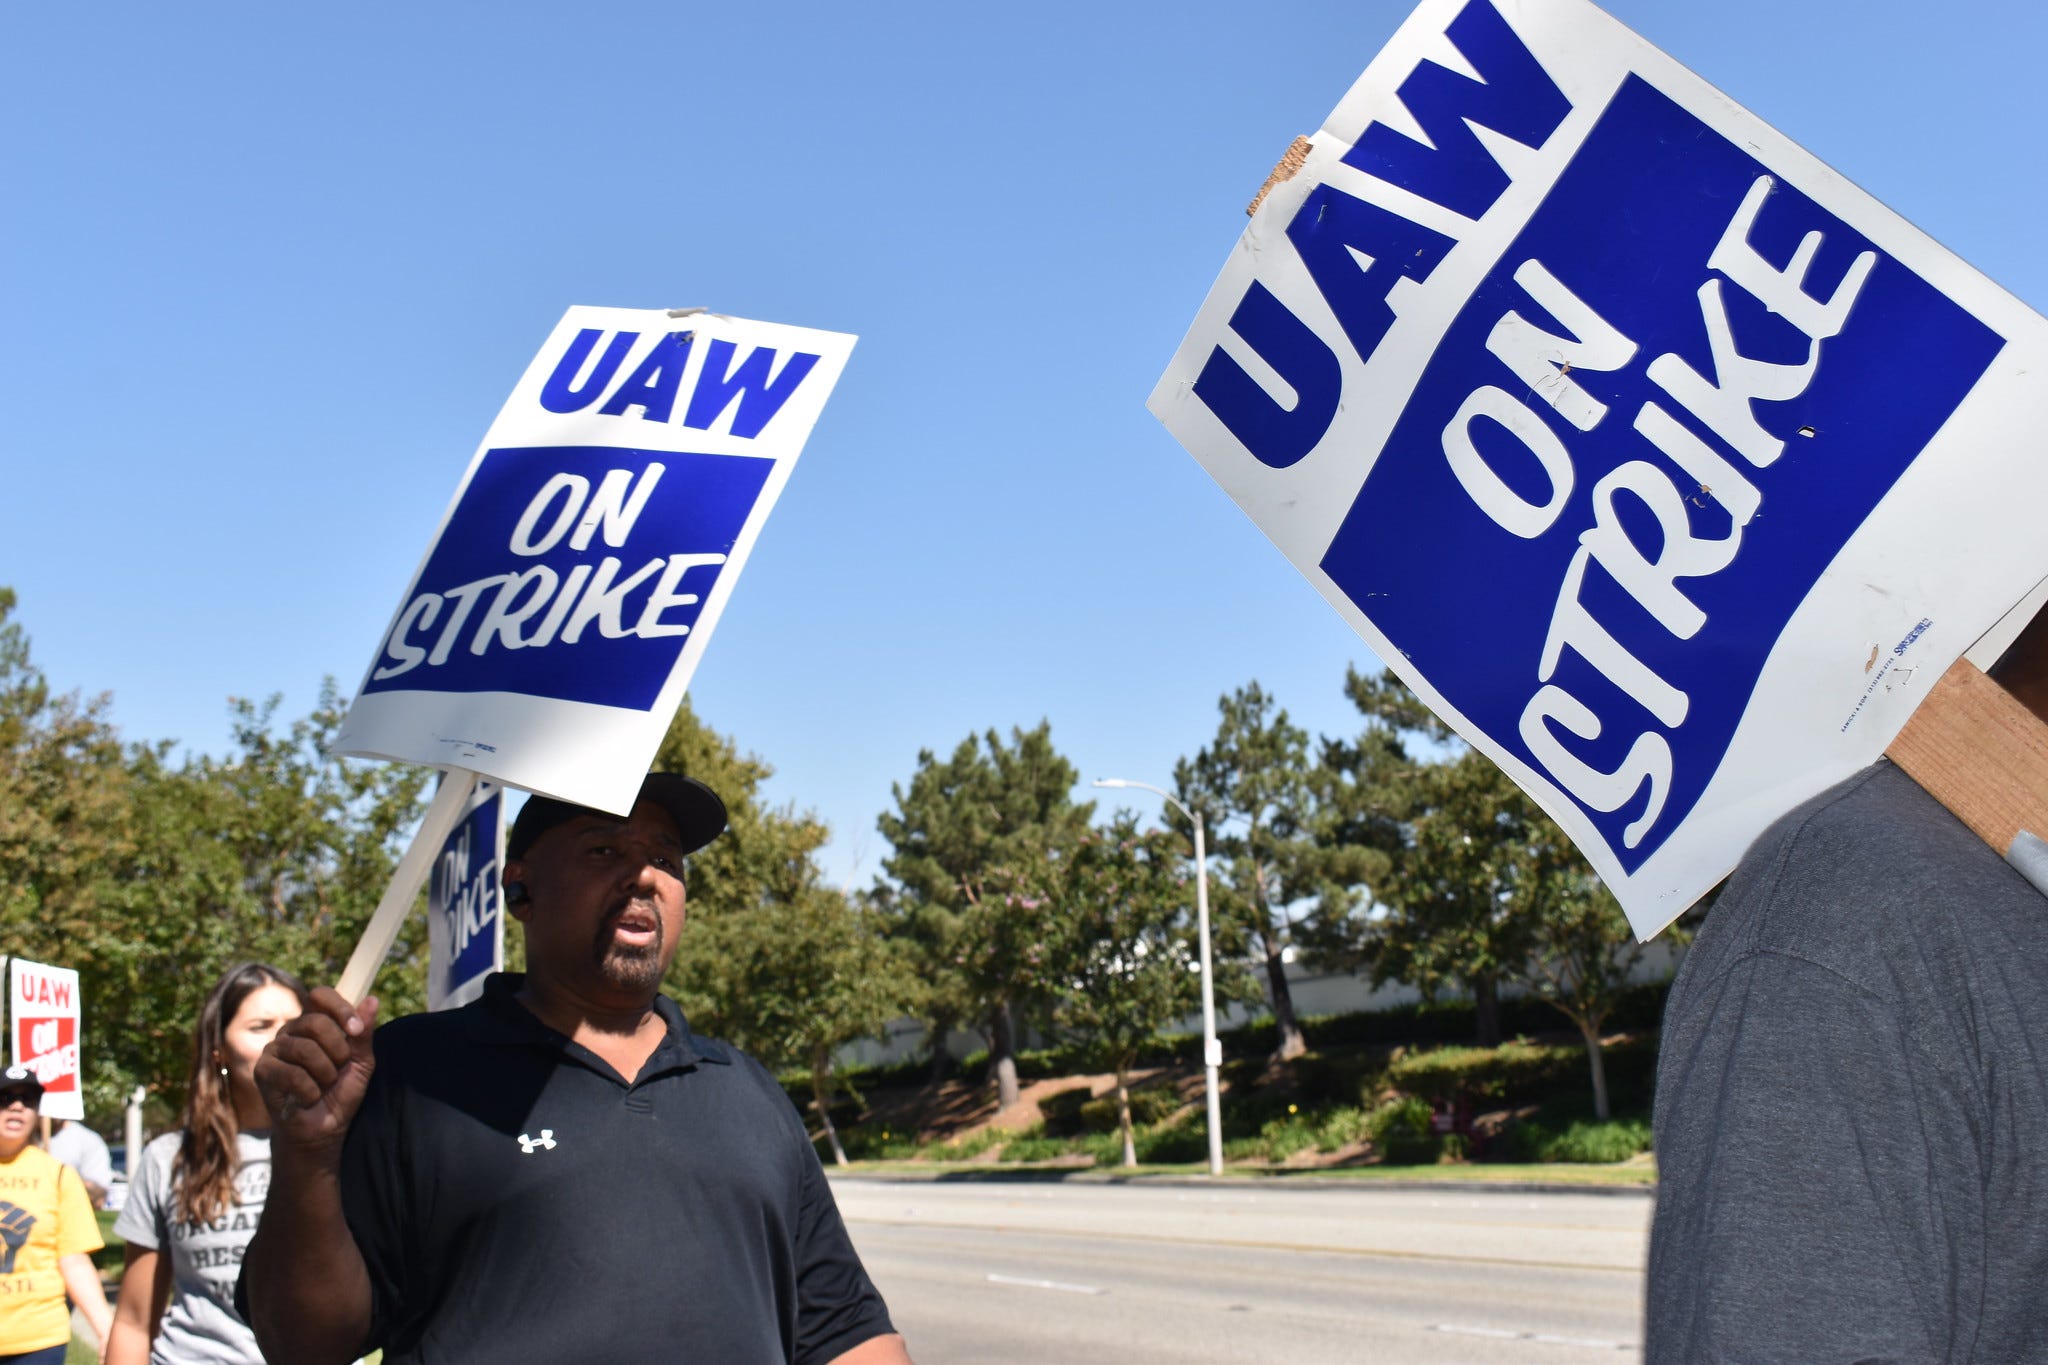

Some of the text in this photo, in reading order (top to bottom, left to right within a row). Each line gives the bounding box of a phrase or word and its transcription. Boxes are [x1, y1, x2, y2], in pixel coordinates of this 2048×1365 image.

[1192, 0, 1574, 469] UAW
[539, 328, 823, 440] UAW
[1441, 258, 1639, 538] ON
[509, 462, 666, 556] ON
[1518, 175, 1877, 849] STRIKE
[373, 553, 727, 681] STRIKE
[441, 823, 471, 912] ON
[21, 973, 71, 1009] UAW
